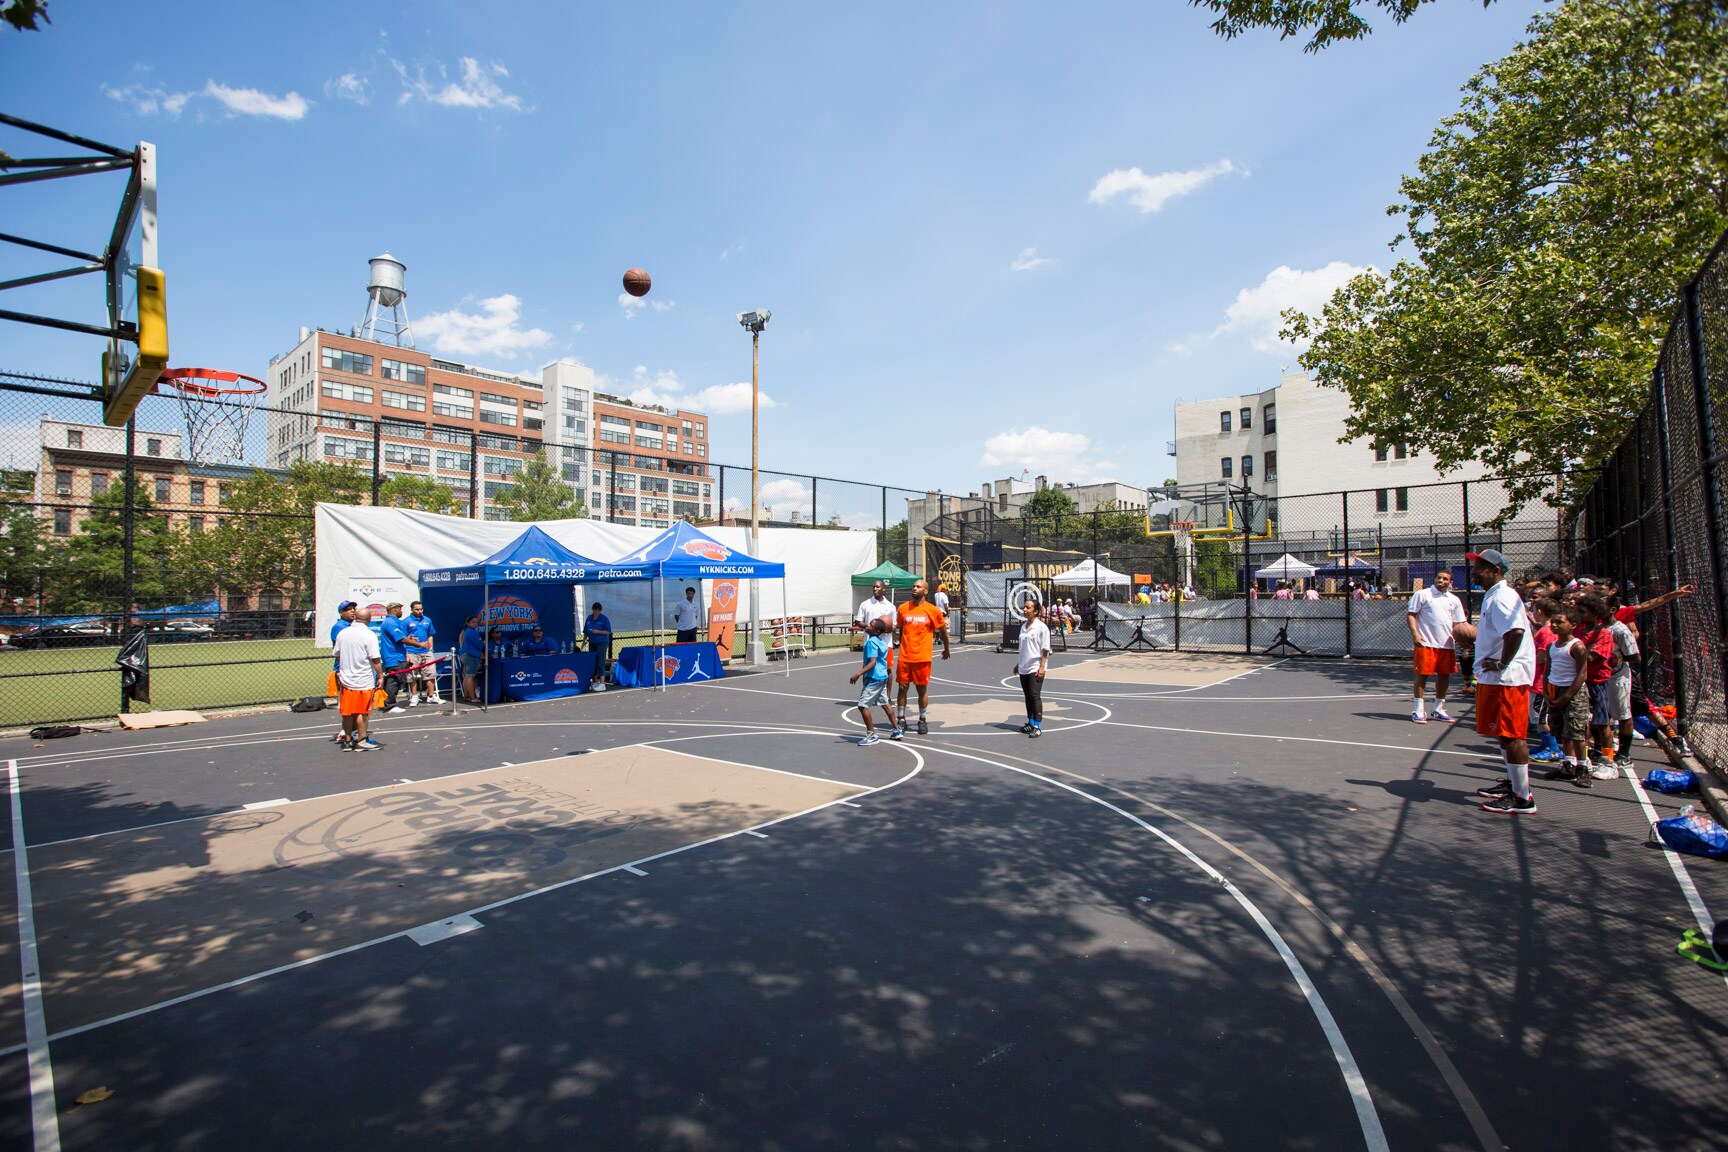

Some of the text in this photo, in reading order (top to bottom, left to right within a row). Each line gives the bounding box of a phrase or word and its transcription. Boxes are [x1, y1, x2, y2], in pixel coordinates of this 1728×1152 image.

[504, 568, 642, 580] 1.800.645.4328 petro.com
[700, 566, 754, 574] NYKNICKS.COM
[455, 571, 480, 583] petro.com
[481, 605, 534, 622] NEW YORK
[713, 612, 733, 622] NY MADE
